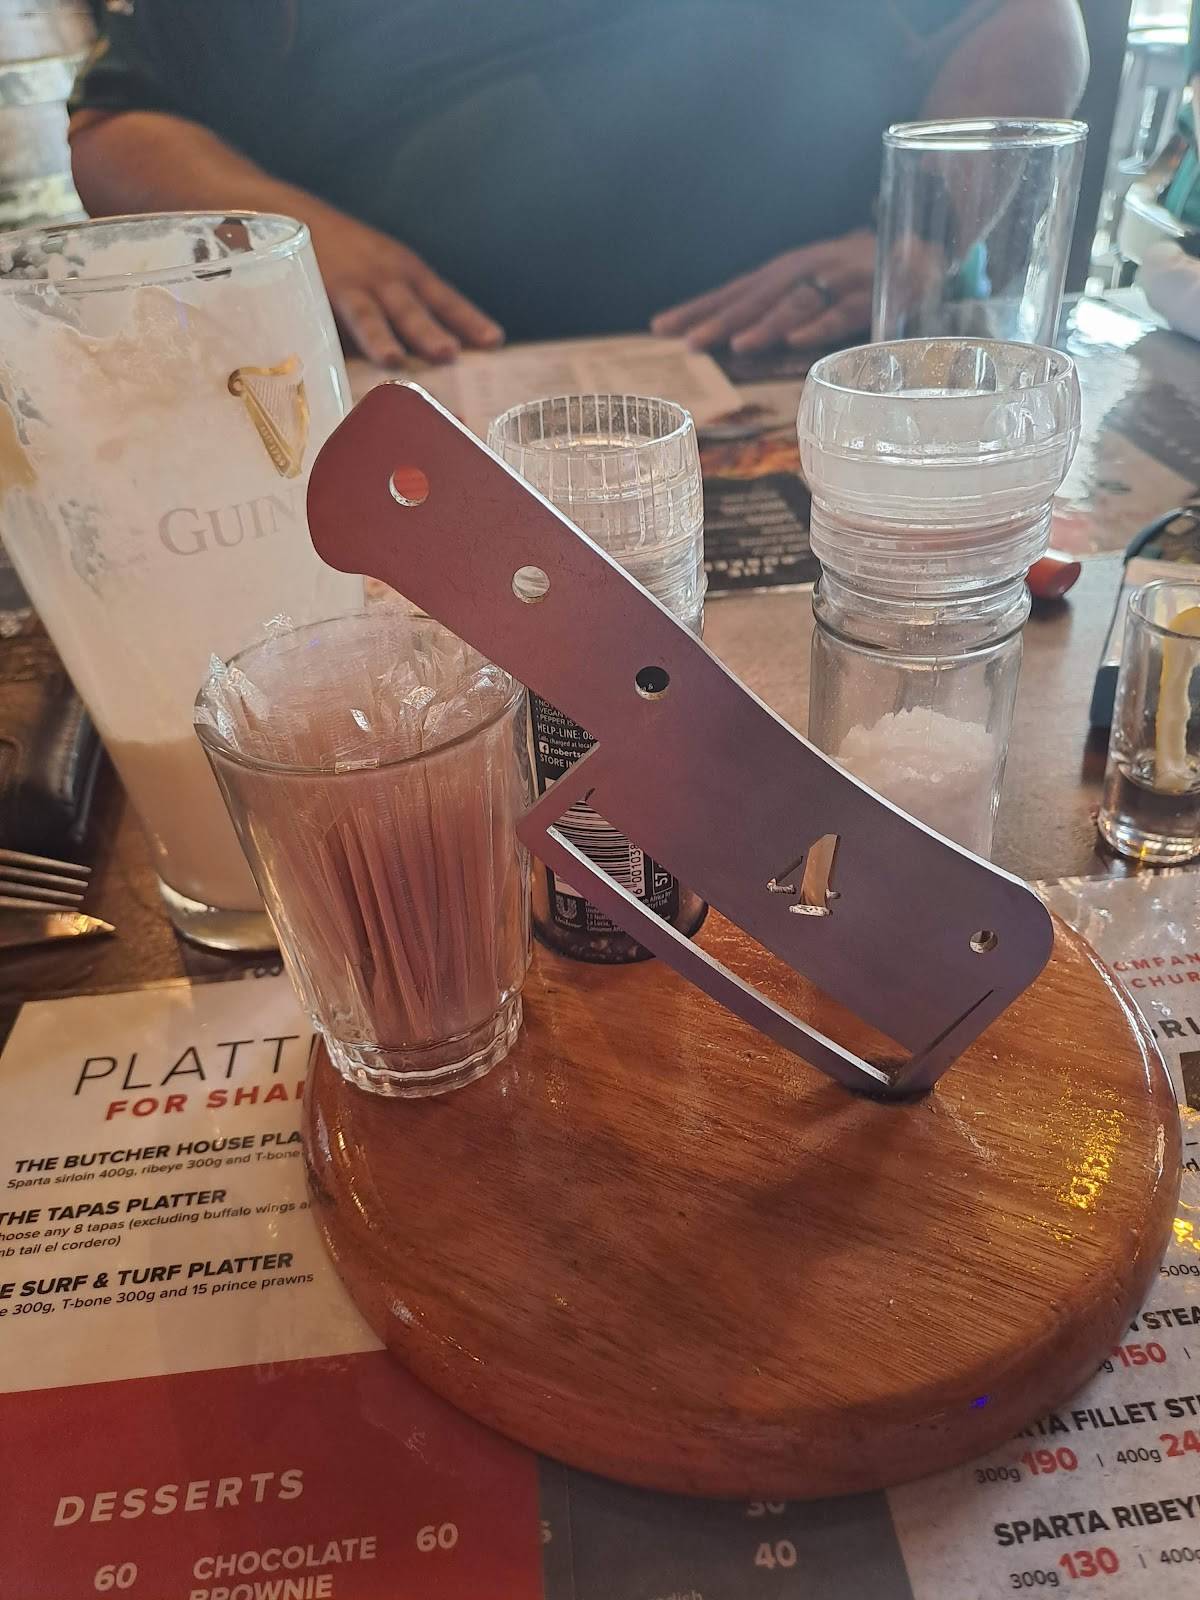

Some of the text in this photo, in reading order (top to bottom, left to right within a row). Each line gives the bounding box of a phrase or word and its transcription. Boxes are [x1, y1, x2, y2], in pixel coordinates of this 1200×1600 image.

[540, 754, 565, 768] STORE
[73, 1033, 317, 1096] PLATT
[105, 1094, 188, 1121] FOR
[7, 1176, 51, 1190] Sparta
[54, 1172, 95, 1184] sirloin
[141, 1163, 183, 1174] ribeye
[186, 1157, 223, 1169] 300g
[225, 1154, 251, 1165] and
[255, 1150, 300, 1162] T-bone
[15, 1157, 59, 1173] THE
[63, 1145, 170, 1169] BUTCHER
[176, 1135, 256, 1156] HOUSE
[0, 1189, 227, 1226] THE TAPAS PLATTER
[44, 1227, 71, 1238] any
[73, 1224, 84, 1234] 8
[87, 1220, 125, 1233] tapas
[128, 1212, 199, 1230] (excluding
[203, 1206, 252, 1219] buffalo
[255, 1201, 296, 1214] wings
[20, 1243, 42, 1255] tail
[45, 1241, 58, 1253] el
[62, 1235, 122, 1251] cordero)
[20, 1275, 89, 1297] SURF
[93, 1272, 109, 1289] &
[118, 1264, 182, 1286] TURF
[187, 1252, 294, 1279] PLATTER
[12, 1301, 56, 1315] 300g,
[62, 1295, 112, 1310] T-bone
[116, 1290, 156, 1303] 300g
[160, 1286, 188, 1299] and
[192, 1283, 208, 1295] 15
[211, 1280, 257, 1295] prince
[261, 1273, 314, 1290] prawns
[1111, 1342, 1167, 1368] 150
[1070, 1401, 1159, 1431] FILLET
[975, 1466, 1021, 1484] 300g
[1021, 1447, 1079, 1476] 190
[1116, 1446, 1162, 1464] 400g
[53, 1468, 304, 1527] DESSERTS
[993, 1509, 1111, 1547] SPARTA
[94, 1523, 459, 1592] 60 CHOCOLATE 60
[754, 1540, 798, 1570] 40
[1008, 1569, 1060, 1590] 300g
[1059, 1546, 1120, 1580] 130
[188, 1573, 334, 1600] BROWNIE
